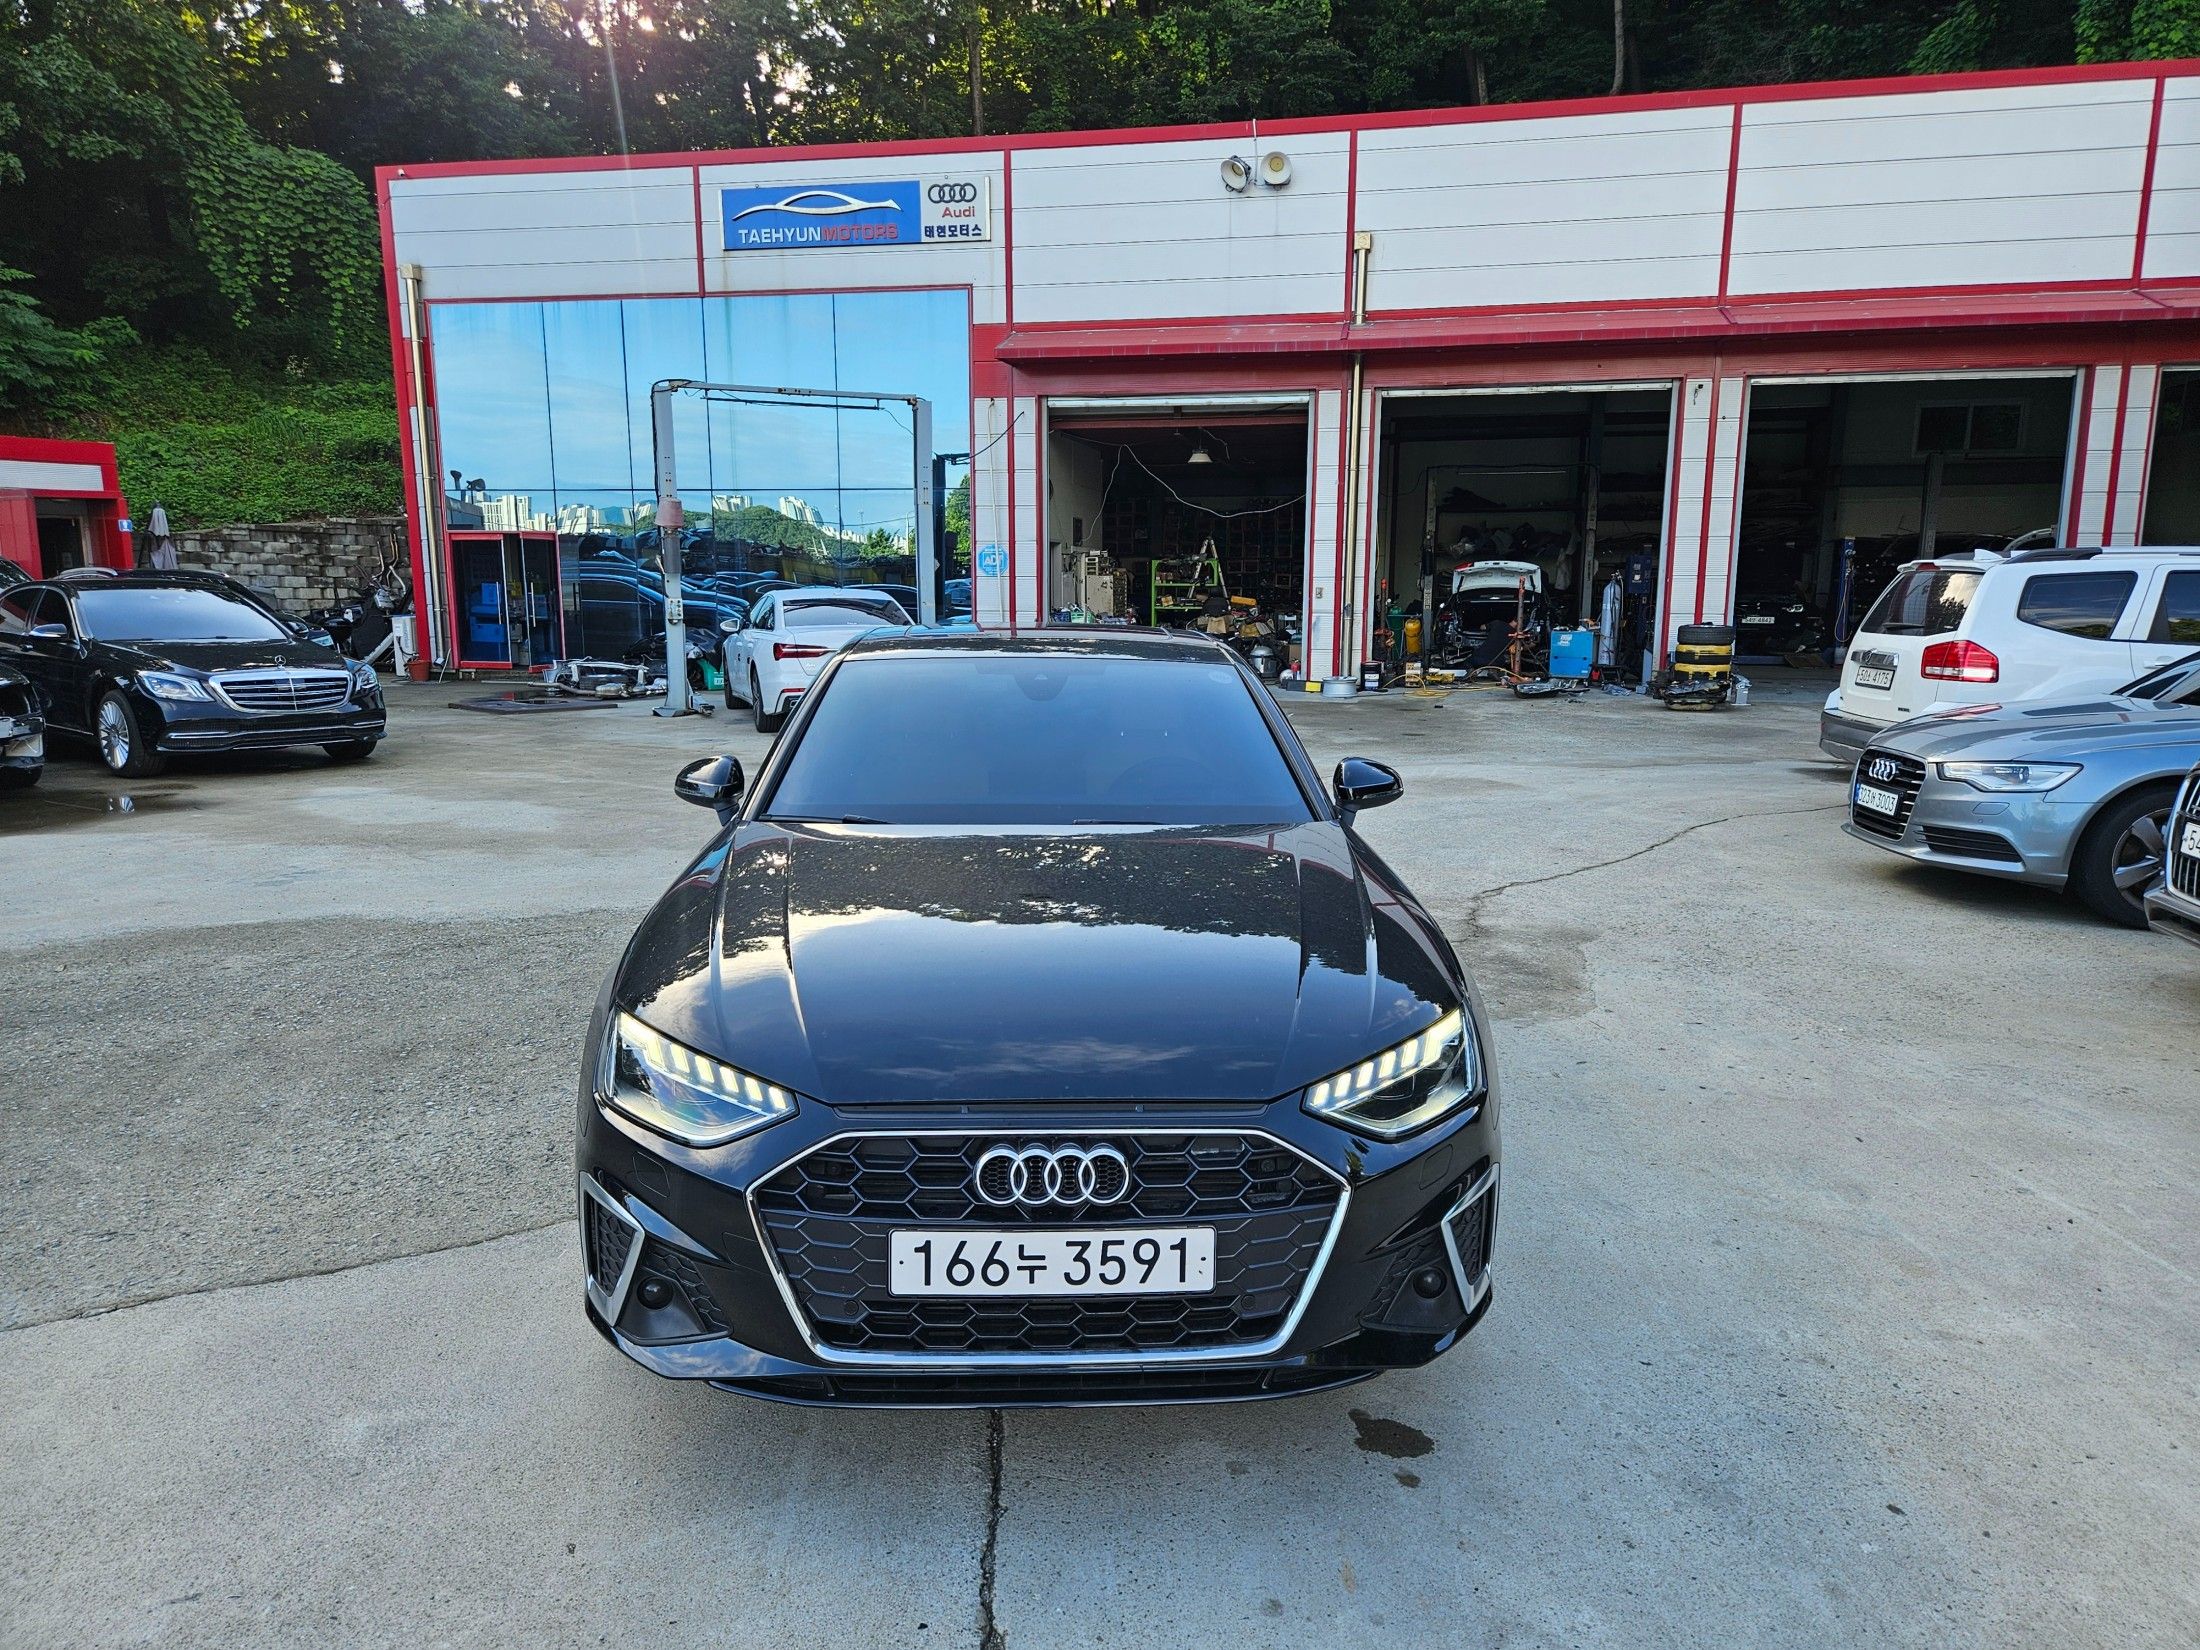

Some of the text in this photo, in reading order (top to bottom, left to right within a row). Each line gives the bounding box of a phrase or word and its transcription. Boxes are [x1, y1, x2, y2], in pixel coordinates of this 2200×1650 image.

[942, 206, 976, 218] Audi
[924, 224, 982, 238] 태현모터스
[1872, 671, 1890, 685] 4175
[1875, 792, 1896, 812] 3003
[914, 1237, 1187, 1287] 166누 3591
